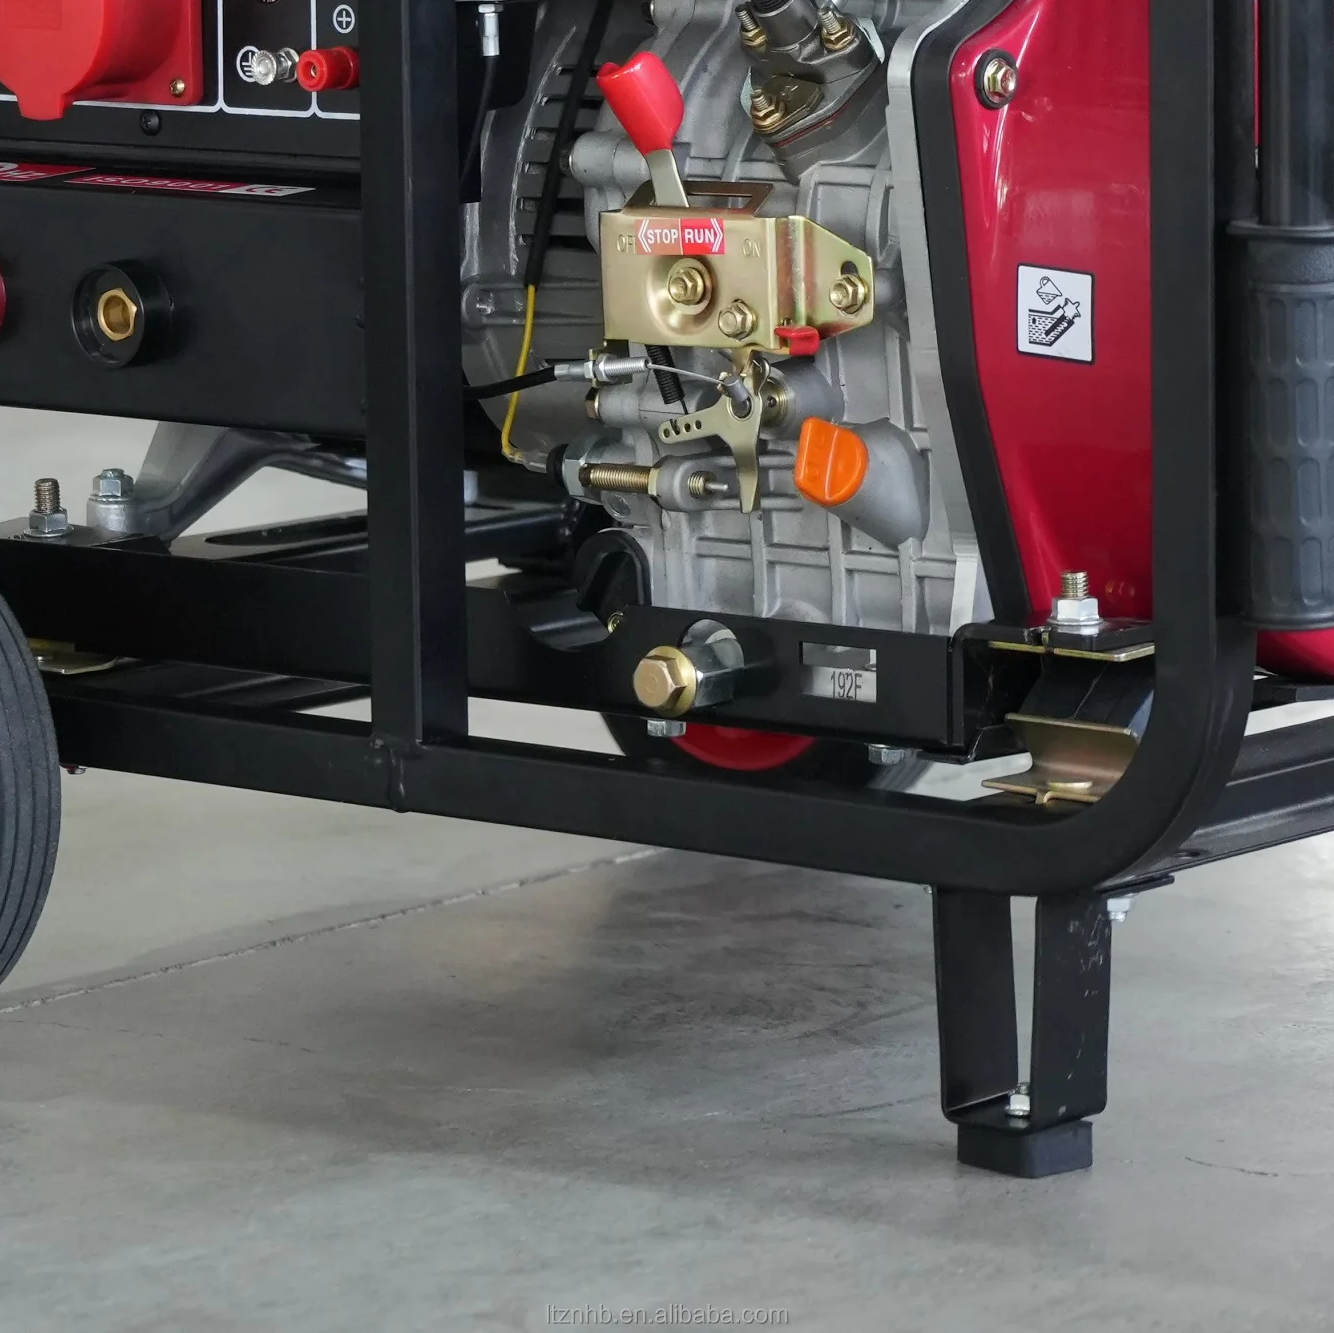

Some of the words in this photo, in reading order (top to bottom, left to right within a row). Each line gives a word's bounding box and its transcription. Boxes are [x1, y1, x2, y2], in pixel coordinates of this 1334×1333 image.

[647, 228, 679, 244] STOP
[685, 228, 715, 244] RUN
[830, 670, 863, 701] 192F
